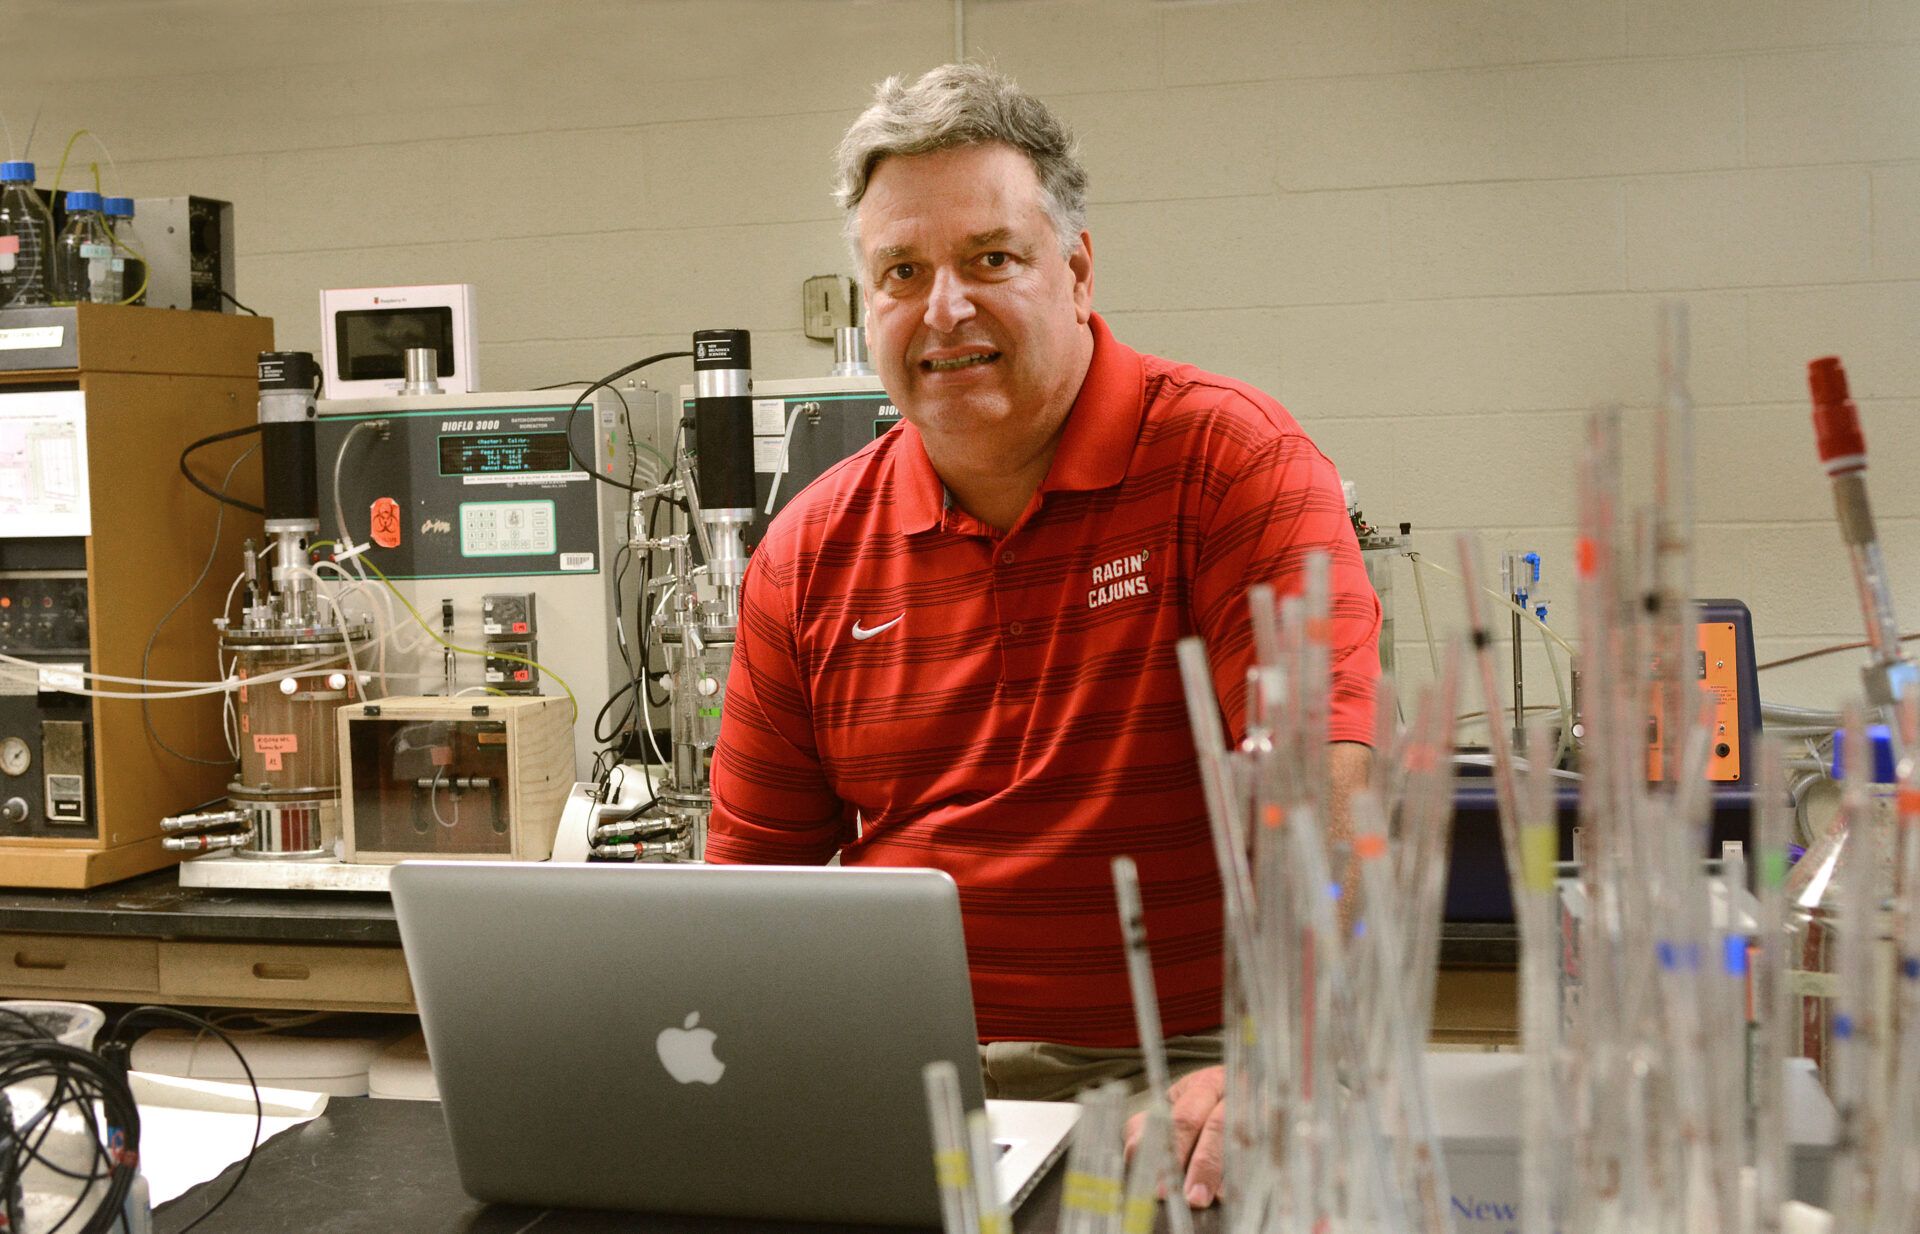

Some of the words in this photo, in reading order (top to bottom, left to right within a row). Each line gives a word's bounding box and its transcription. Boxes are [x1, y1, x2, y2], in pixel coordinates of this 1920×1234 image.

[441, 420, 473, 431] BIOFLO
[475, 420, 500, 431] 3000
[1088, 575, 1149, 609] CAJUNS
[1450, 1195, 1520, 1222] New
